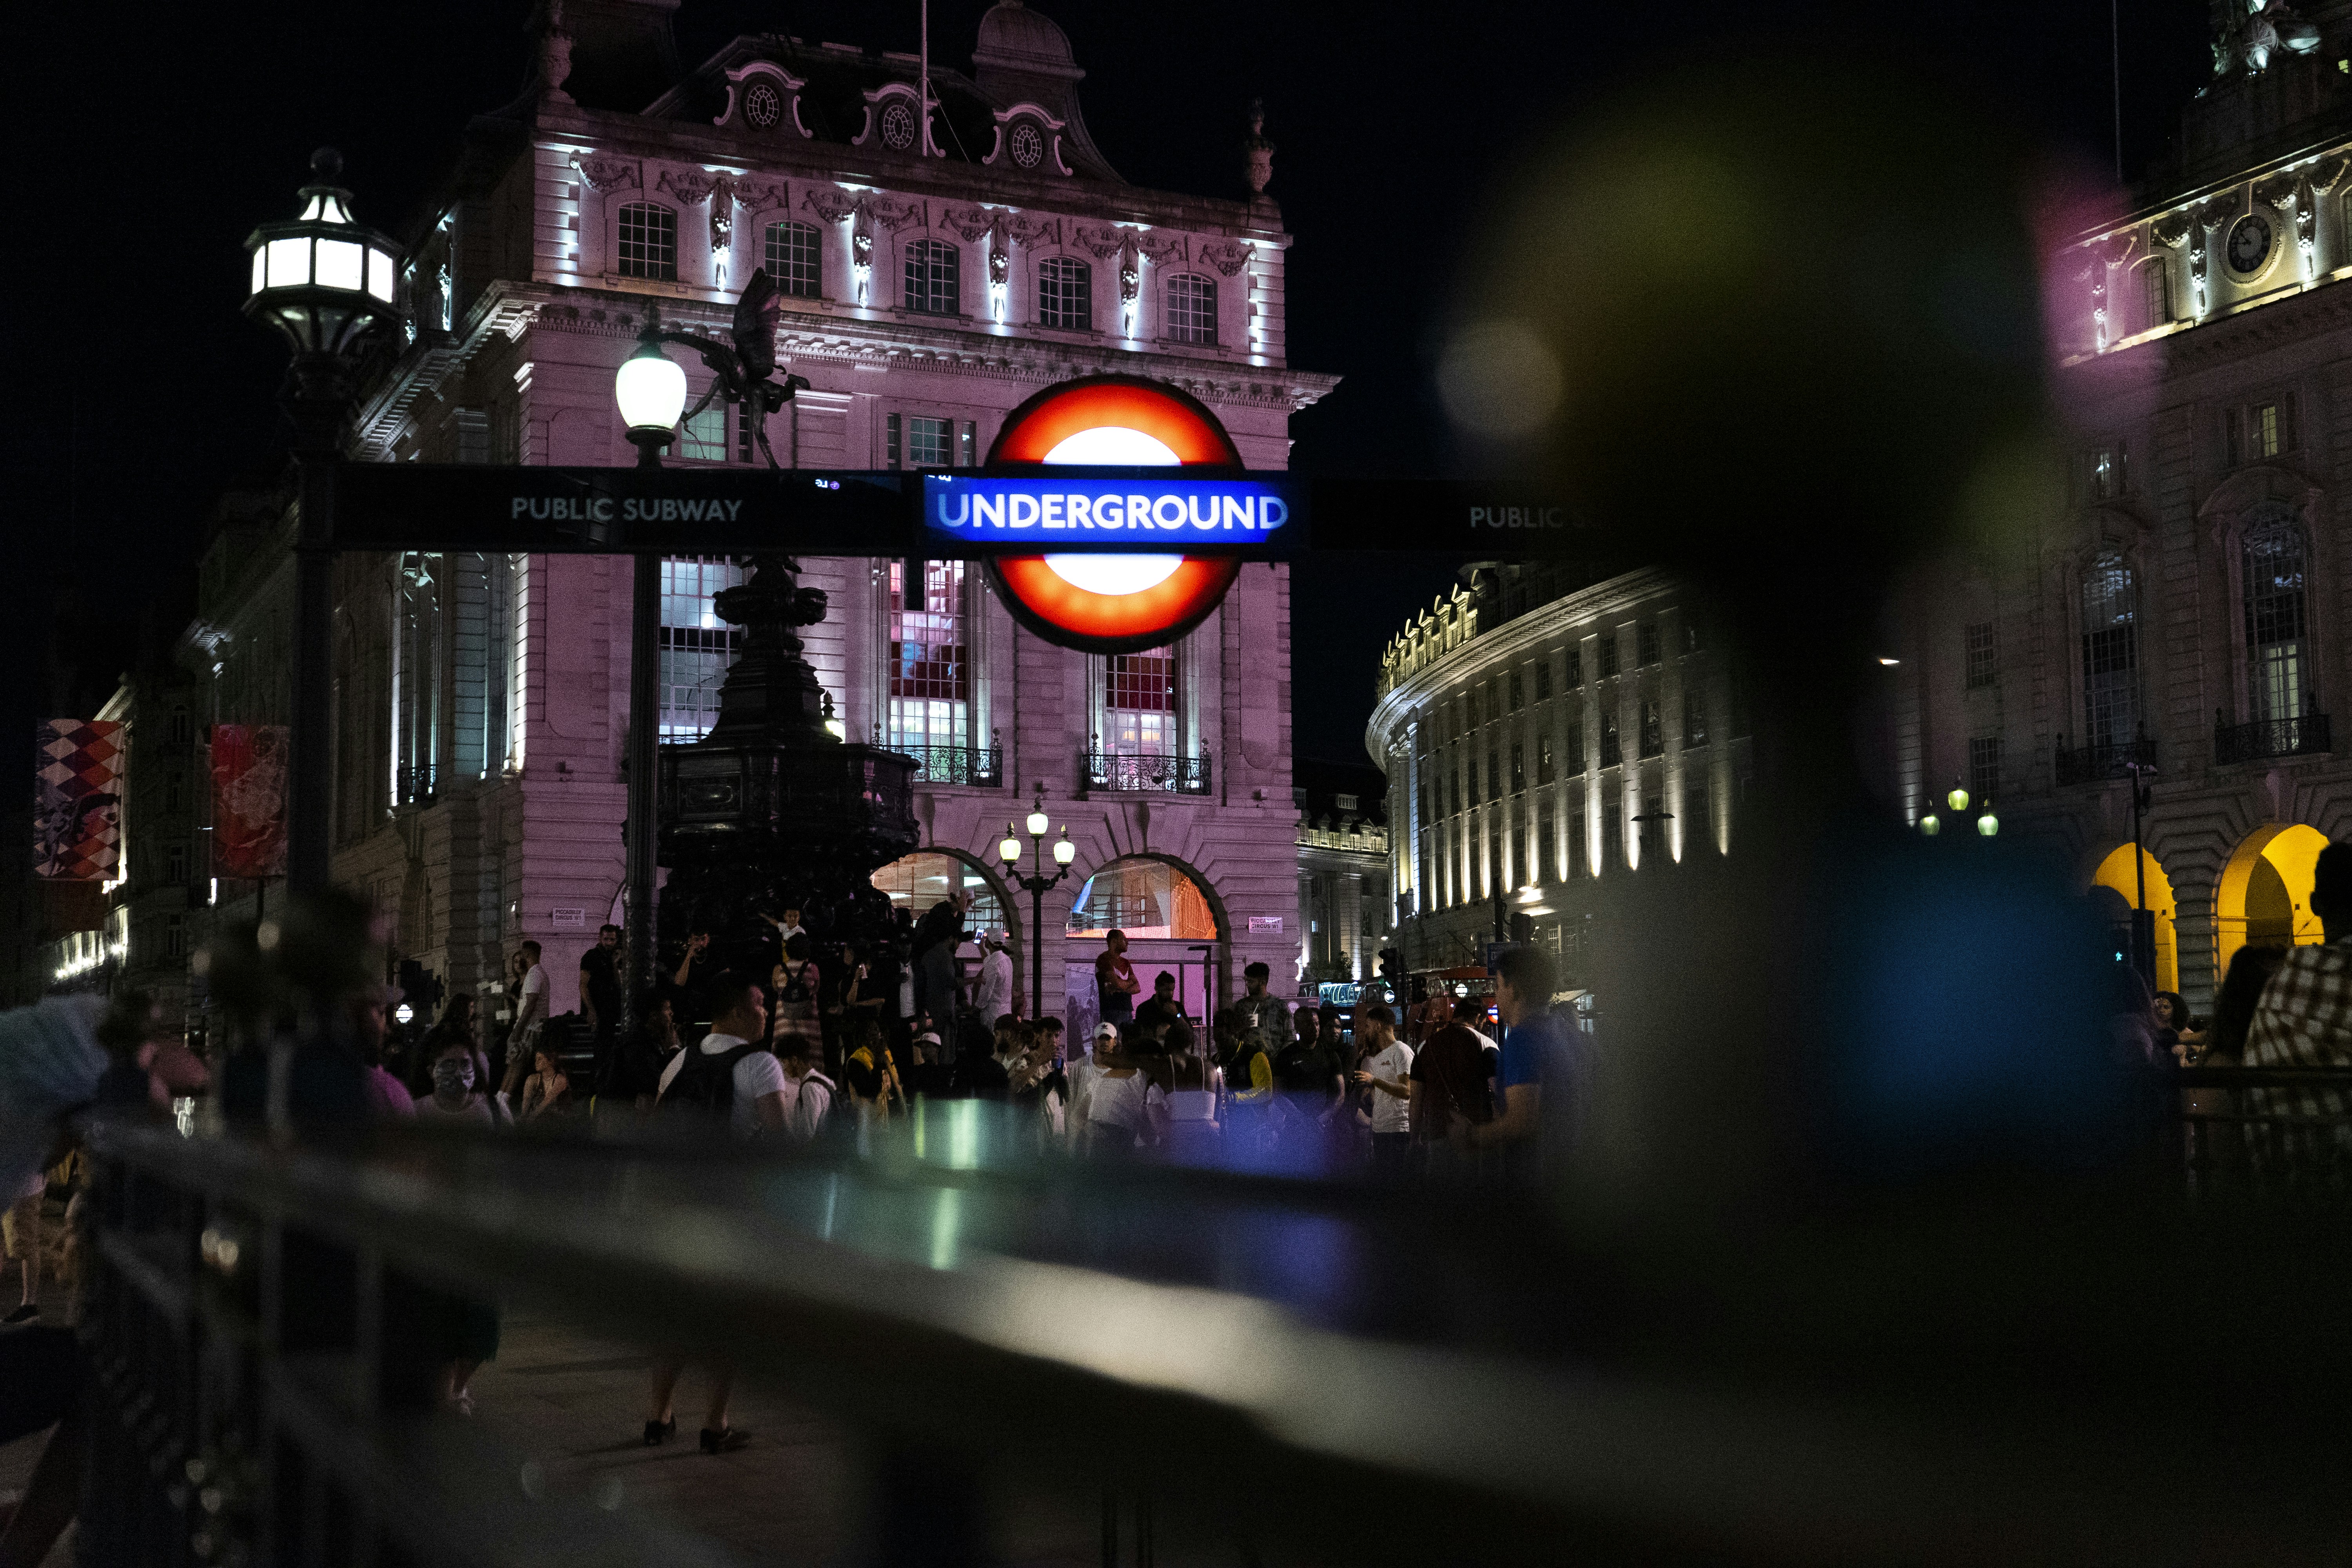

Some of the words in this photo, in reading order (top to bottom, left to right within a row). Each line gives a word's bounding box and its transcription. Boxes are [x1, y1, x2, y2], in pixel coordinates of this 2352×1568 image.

[512, 496, 613, 522] PUBLIC
[622, 497, 743, 523] SUBWAY
[938, 494, 1289, 530] UNDERGROUND
[1470, 506, 1563, 528] PUBLIC
